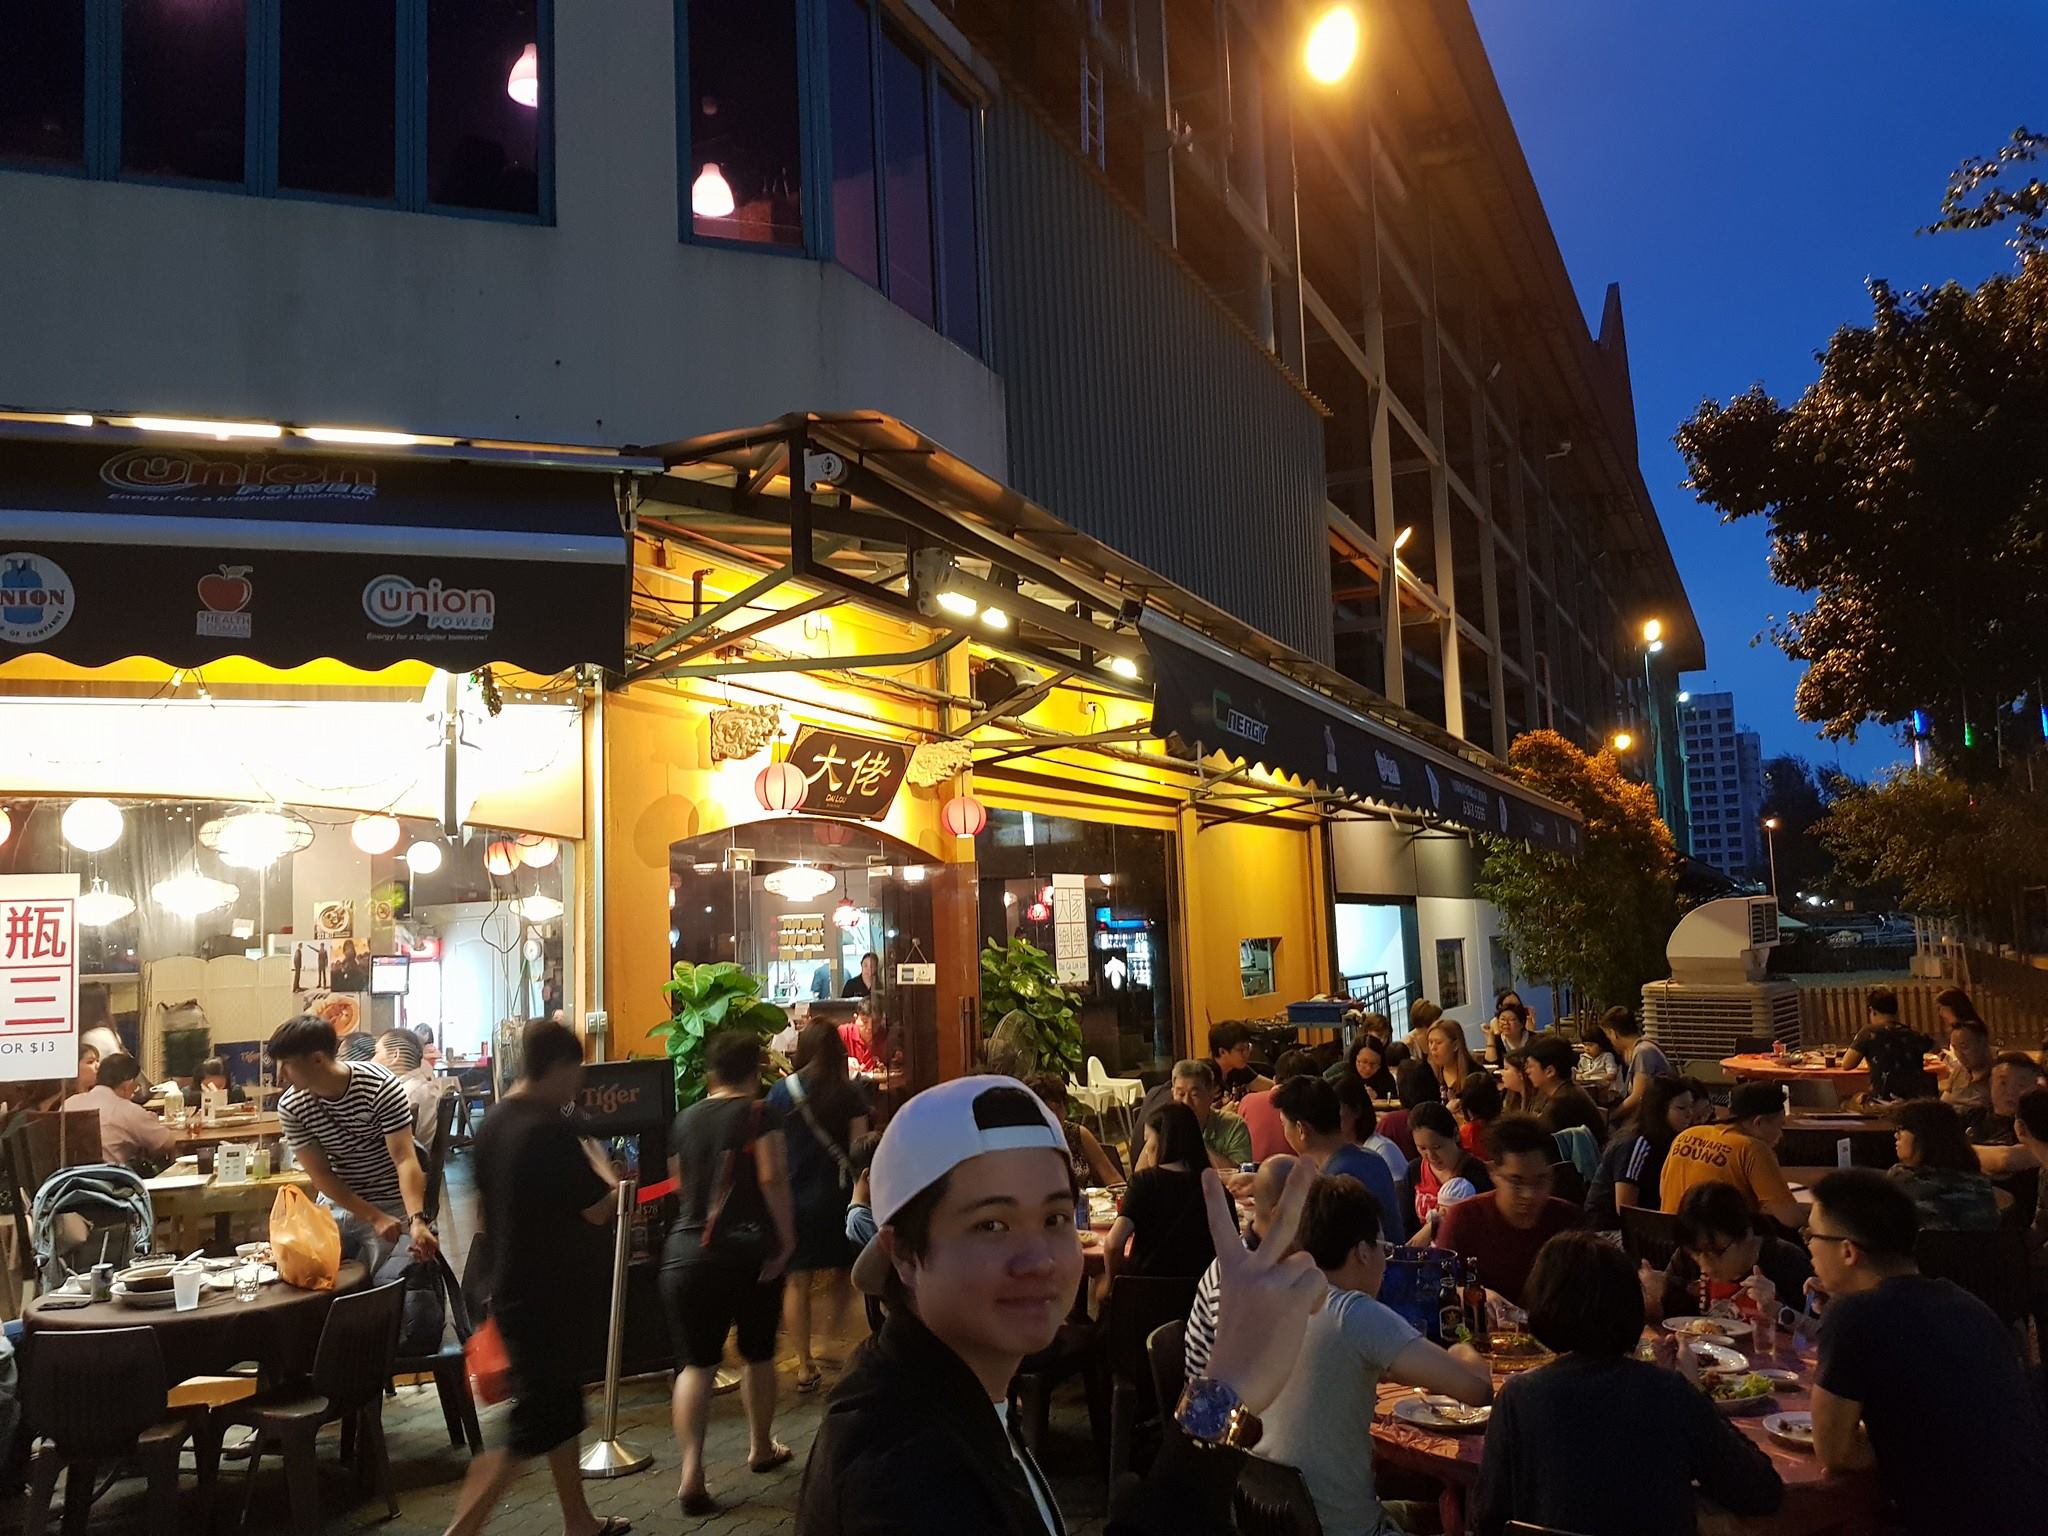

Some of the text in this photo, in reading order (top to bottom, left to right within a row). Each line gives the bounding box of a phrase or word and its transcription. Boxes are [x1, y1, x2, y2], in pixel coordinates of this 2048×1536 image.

[429, 616, 491, 628] POWER
[5, 905, 67, 960] 瓶
[5, 976, 65, 1026] 三
[31, 1041, 55, 1054] $13
[580, 1083, 641, 1113] Tiger
[1672, 1144, 1728, 1168] BOUND
